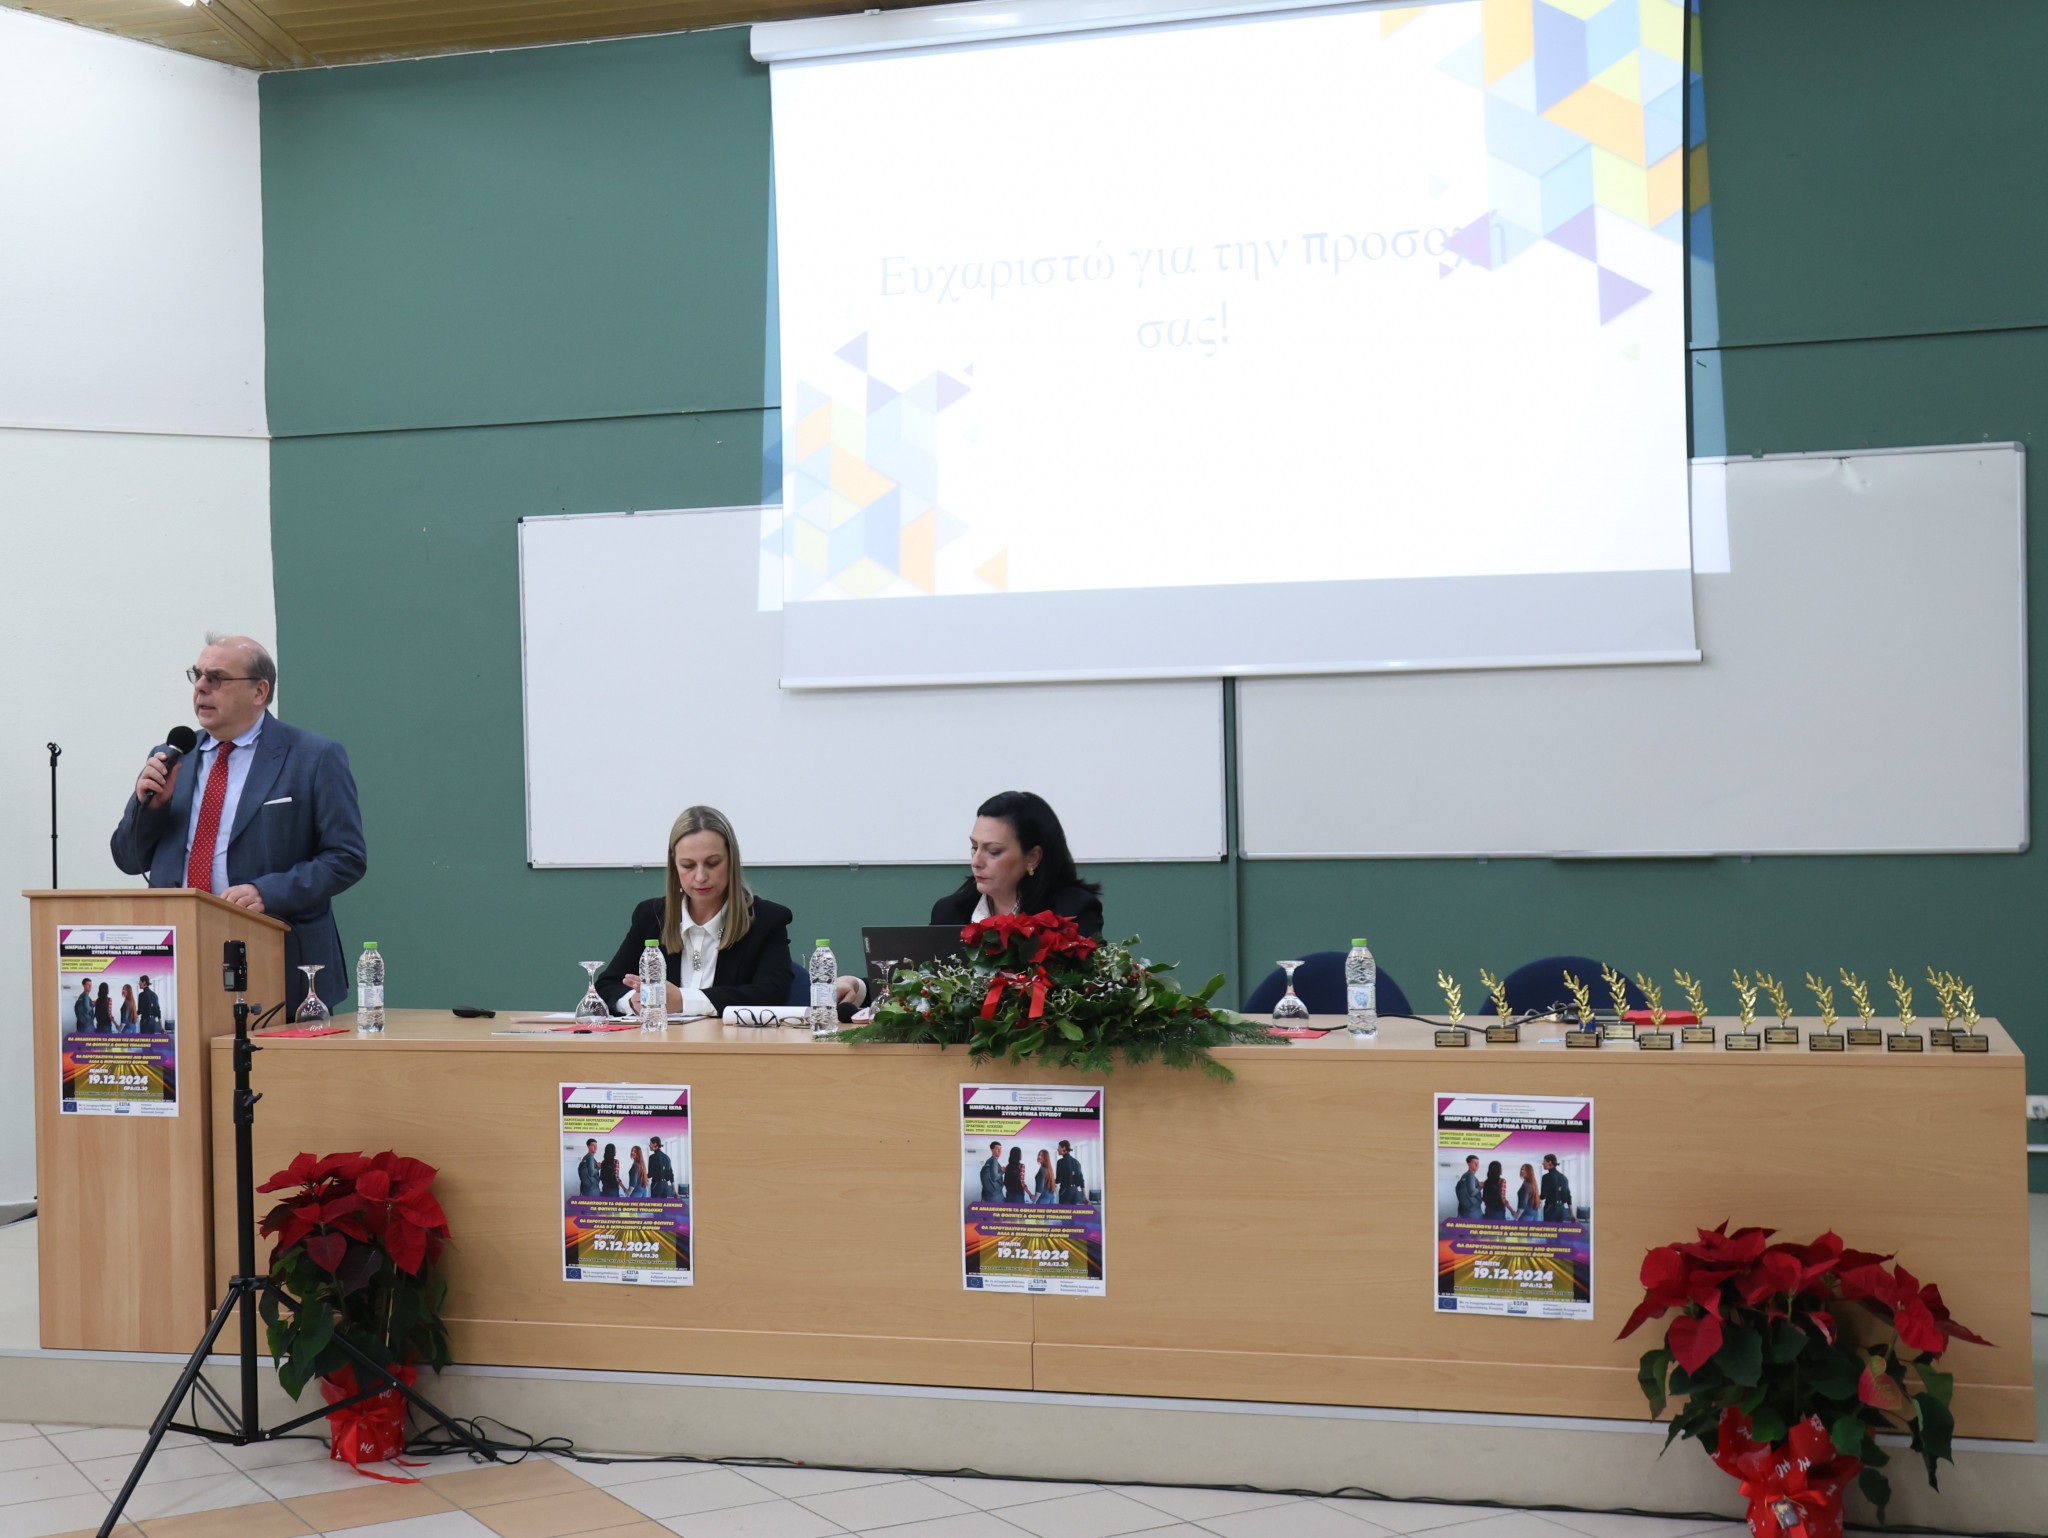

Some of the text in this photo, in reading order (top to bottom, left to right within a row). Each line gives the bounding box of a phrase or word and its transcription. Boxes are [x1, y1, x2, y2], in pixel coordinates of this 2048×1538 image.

[879, 239, 1115, 304] Ευχαριστώ
[1130, 243, 1196, 288] για
[1213, 238, 1287, 281] την
[1137, 300, 1229, 357] σας!
[89, 1074, 148, 1085] 19.12.2024
[594, 1240, 660, 1253] 19.12.2024
[997, 1247, 1069, 1261] 19.12.2024
[1473, 1267, 1553, 1282] 19.12.2024
